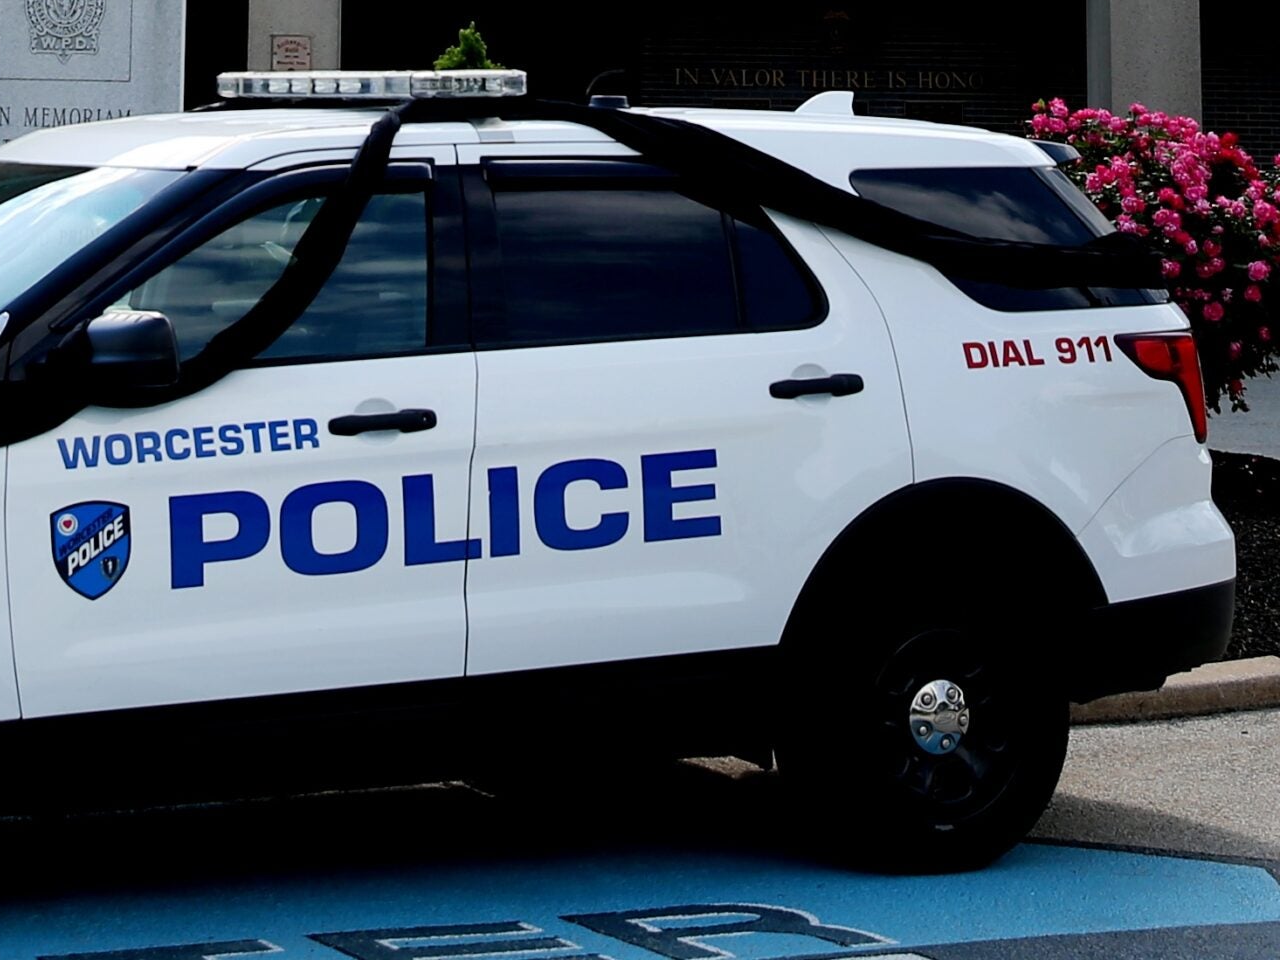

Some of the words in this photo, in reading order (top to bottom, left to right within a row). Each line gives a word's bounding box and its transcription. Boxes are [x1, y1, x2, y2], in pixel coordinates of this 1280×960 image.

[675, 67, 699, 86] IN
[710, 68, 786, 87] VALOR
[796, 69, 876, 88] THERE
[887, 71, 907, 88] IS
[962, 339, 1045, 369] DIAL
[1055, 336, 1112, 364] 911
[57, 417, 320, 470] WORCESTER
[67, 514, 124, 577] POLICE
[169, 448, 722, 590] POLICE
